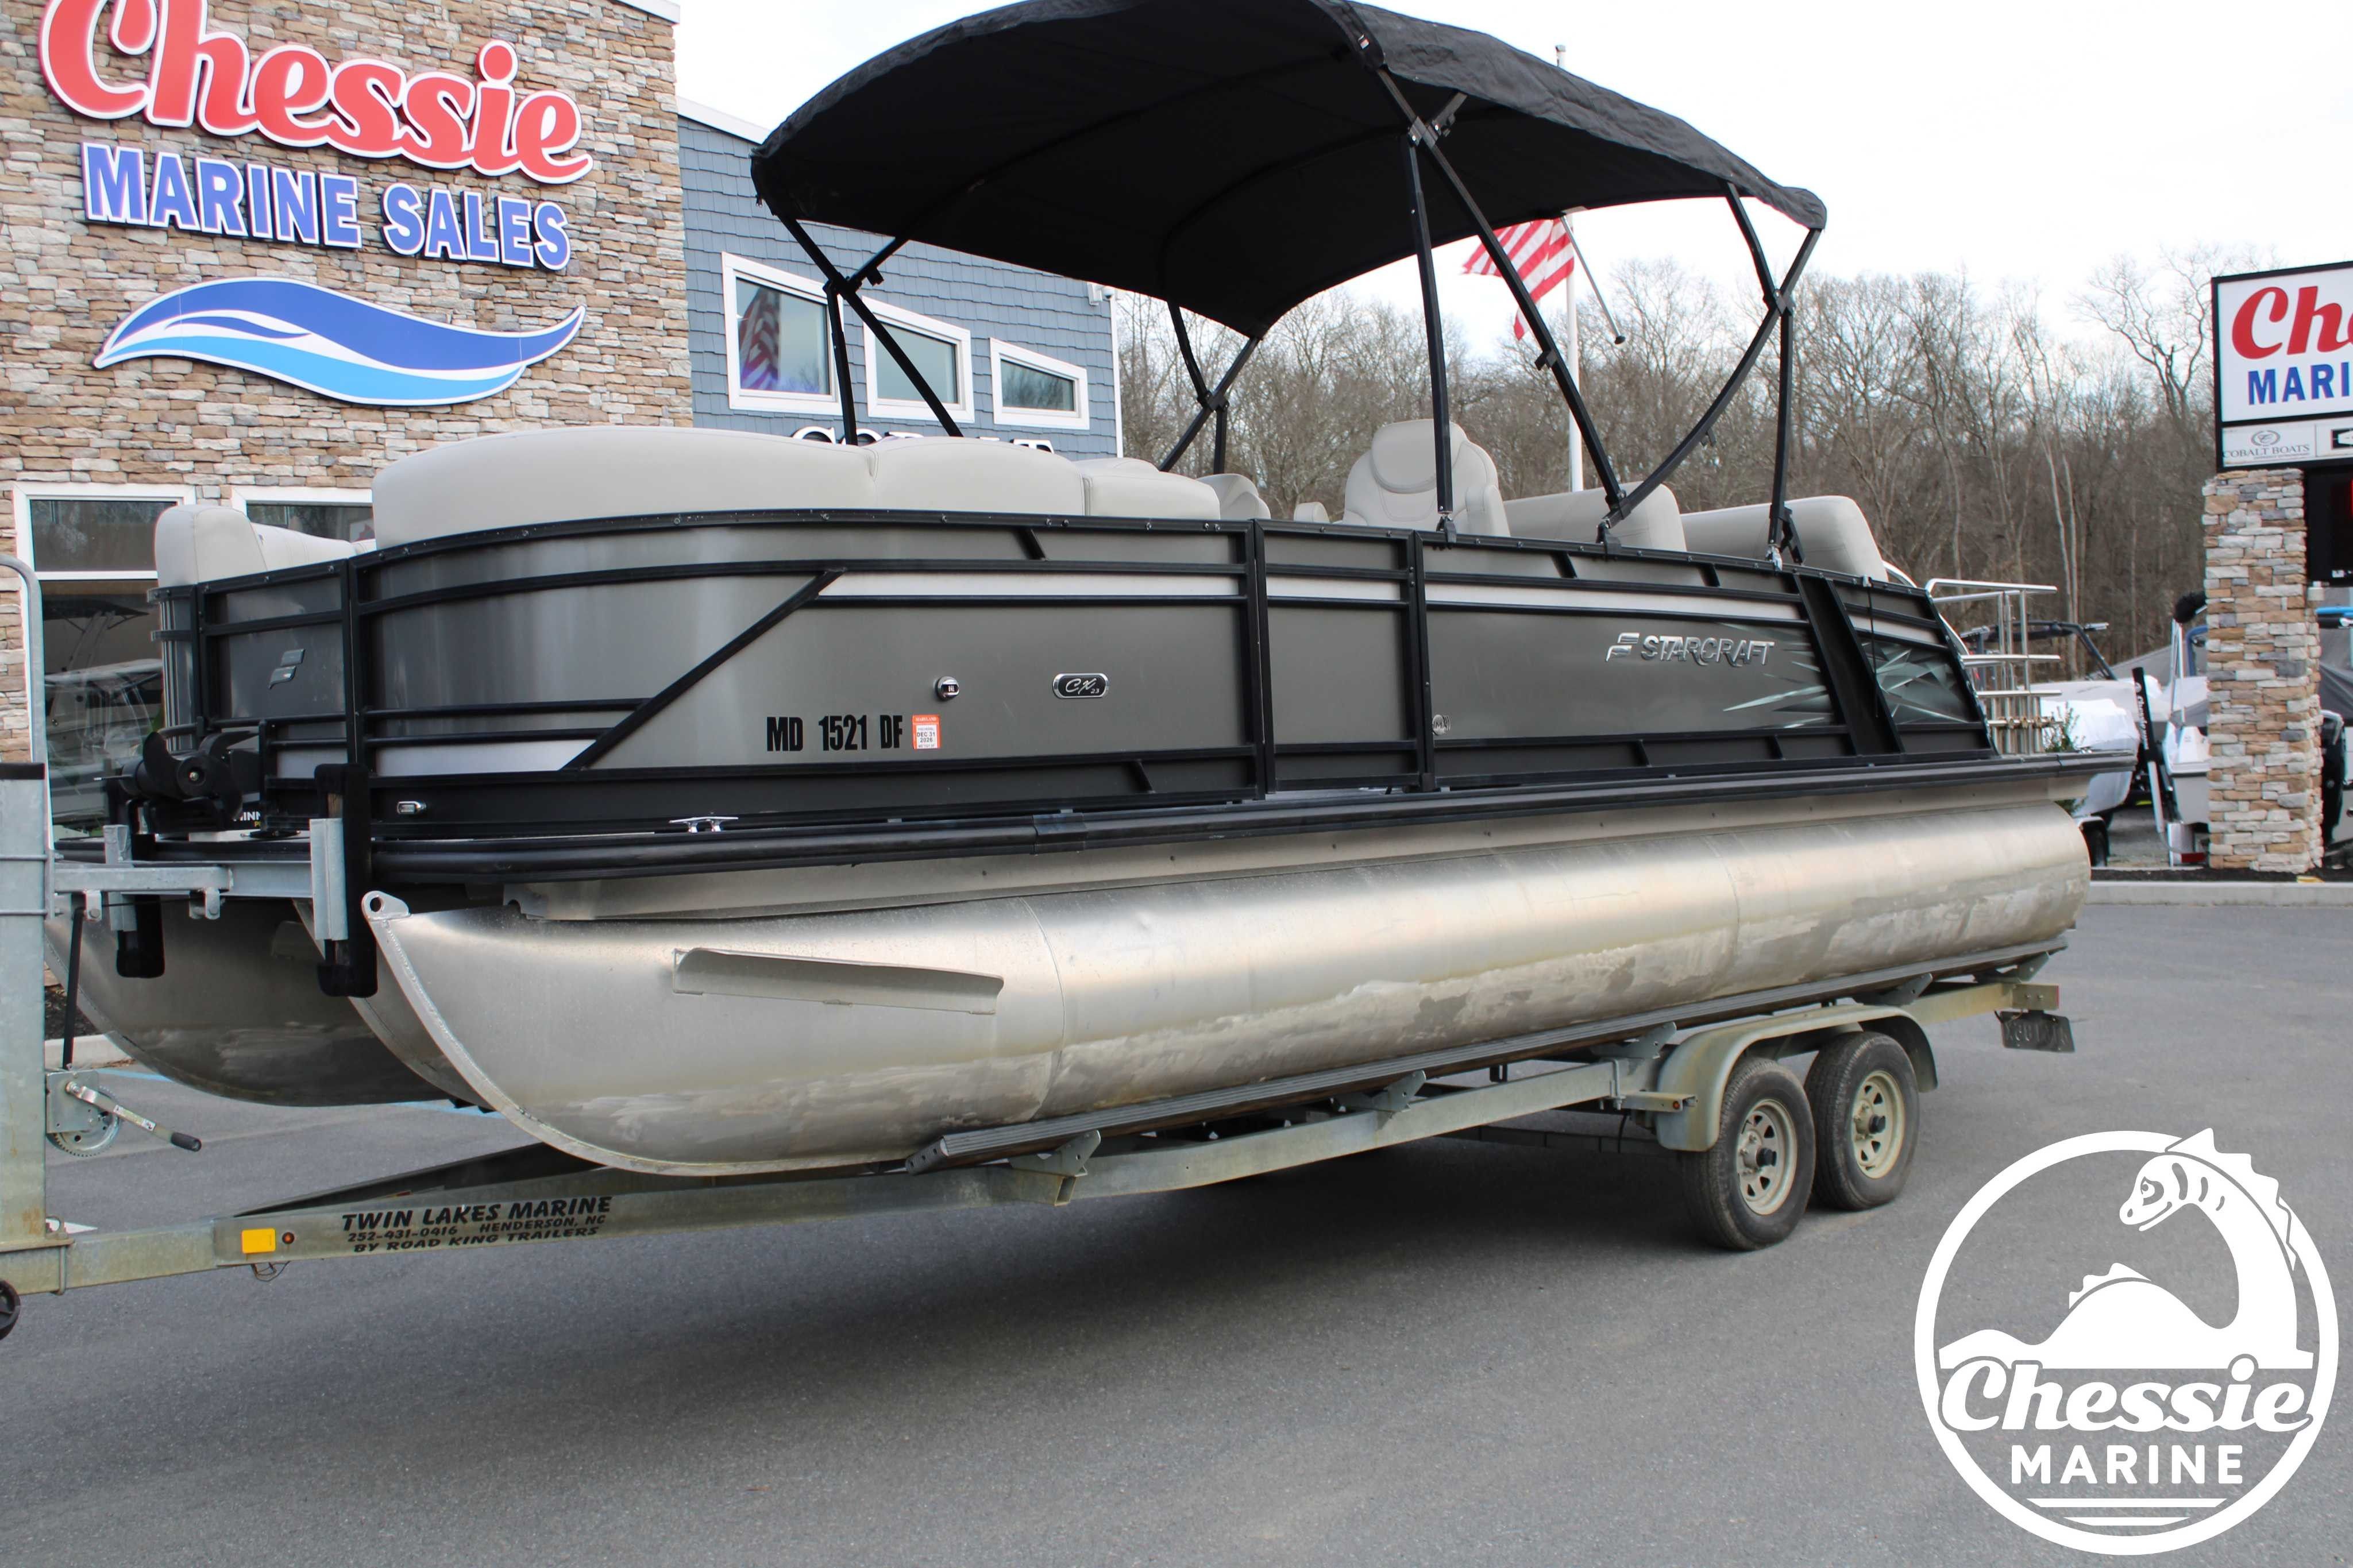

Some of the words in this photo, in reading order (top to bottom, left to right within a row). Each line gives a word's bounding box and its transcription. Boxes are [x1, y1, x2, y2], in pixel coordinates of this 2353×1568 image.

[39, 0, 593, 184] Chessie
[81, 142, 362, 249] MARINE
[381, 183, 571, 271] SALES
[2232, 285, 2353, 360] Ch
[2248, 362, 2349, 405] MARI
[2223, 447, 2269, 458] COBALT
[2272, 445, 2310, 454] BOATS
[1641, 635, 1775, 667] STARCRAFT
[1066, 678, 1097, 694] CX
[766, 716, 804, 751] MD
[818, 714, 867, 751] 1521
[880, 715, 903, 749] DF
[342, 1210, 414, 1231] TWIN
[422, 1204, 502, 1225] LAKES
[508, 1196, 612, 1219] MARINE
[348, 1226, 458, 1242] 252-431-0416
[479, 1216, 578, 1233] HENDERSON,
[585, 1215, 606, 1225] NC
[353, 1242, 380, 1253] BY
[386, 1238, 441, 1250] ROAD
[448, 1234, 499, 1246] KING
[507, 1226, 600, 1242] TRAILERS
